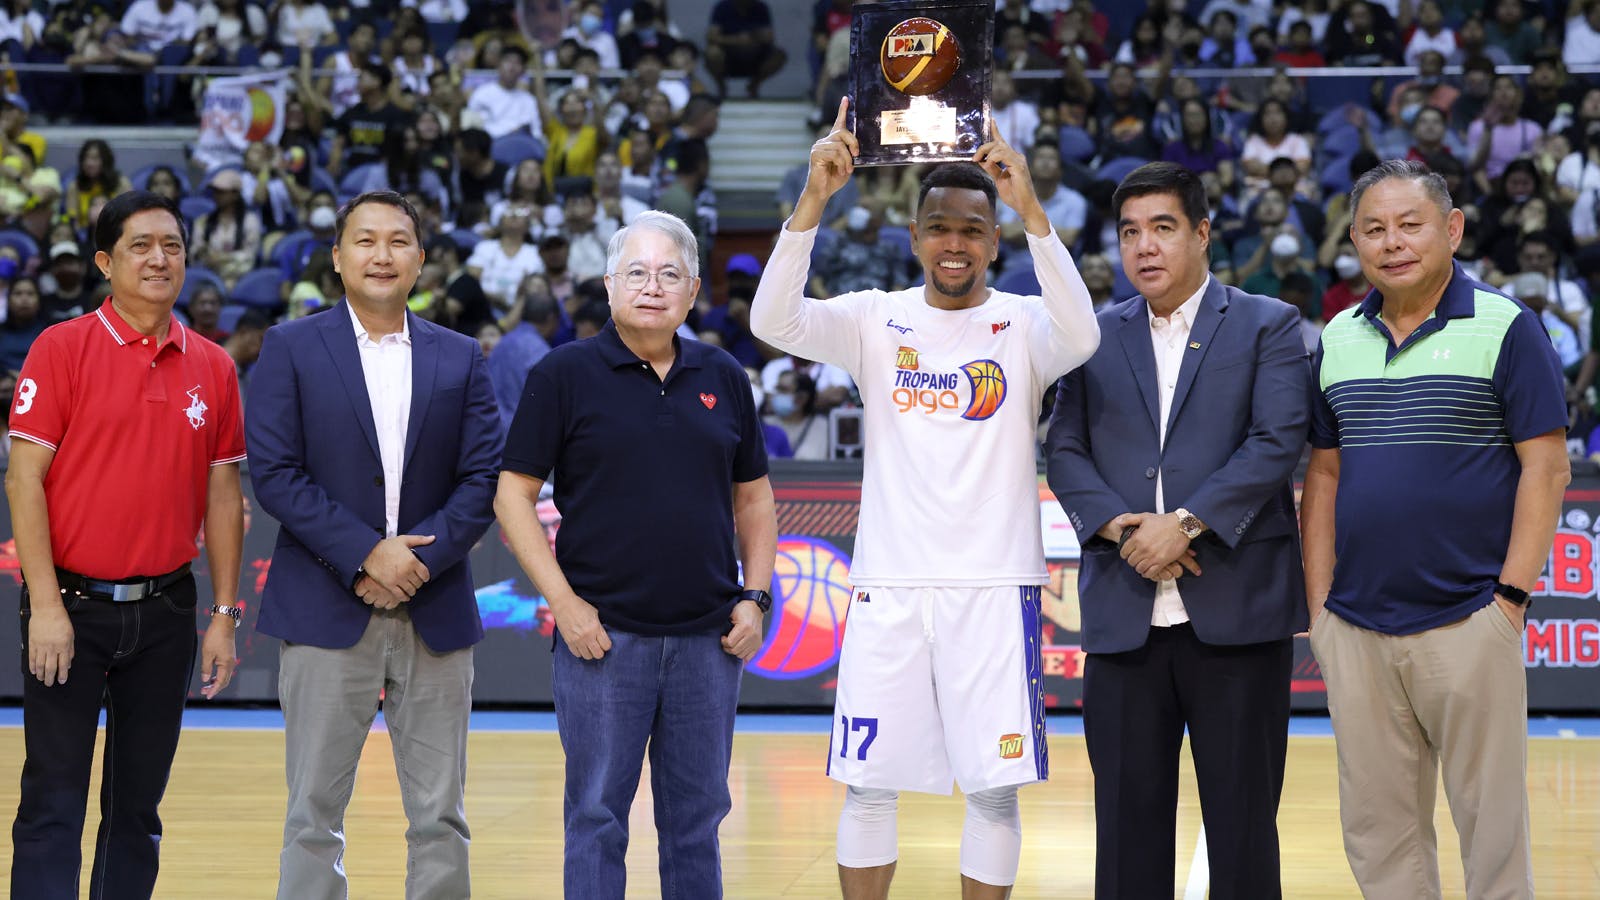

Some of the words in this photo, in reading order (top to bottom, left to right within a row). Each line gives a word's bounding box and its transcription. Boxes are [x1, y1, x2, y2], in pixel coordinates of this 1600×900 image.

[895, 350, 919, 367] TNT
[895, 369, 959, 390] TROPANG
[15, 377, 38, 415] 3
[892, 388, 959, 414] giga
[840, 714, 879, 761] 17
[998, 734, 1026, 758] TNT
